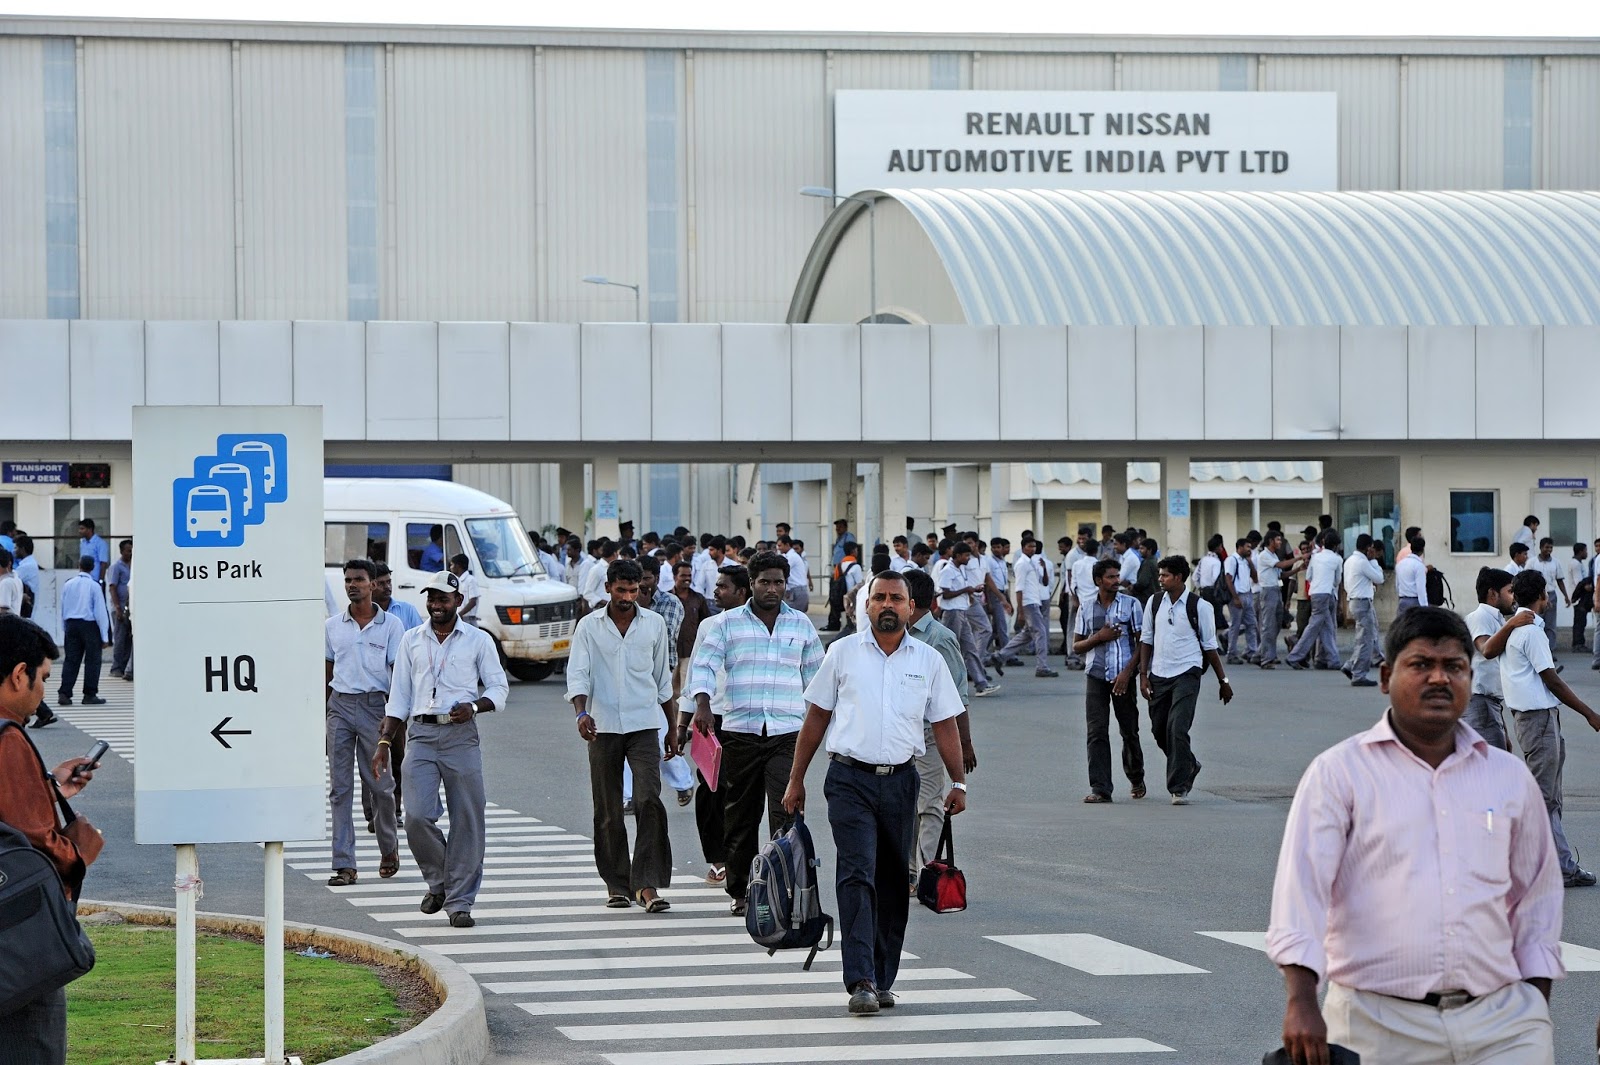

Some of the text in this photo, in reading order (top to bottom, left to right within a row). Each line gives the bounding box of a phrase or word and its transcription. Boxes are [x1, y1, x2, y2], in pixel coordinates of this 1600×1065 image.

[966, 112, 1210, 136] RENAULT NISSAN
[887, 149, 1289, 174] AUTOMOTIVE INDIA PVT LTD
[10, 464, 63, 472] TRANSPORT
[12, 474, 62, 482] HELP DESK
[172, 560, 263, 580] Bus Park
[204, 654, 258, 693] HQ
